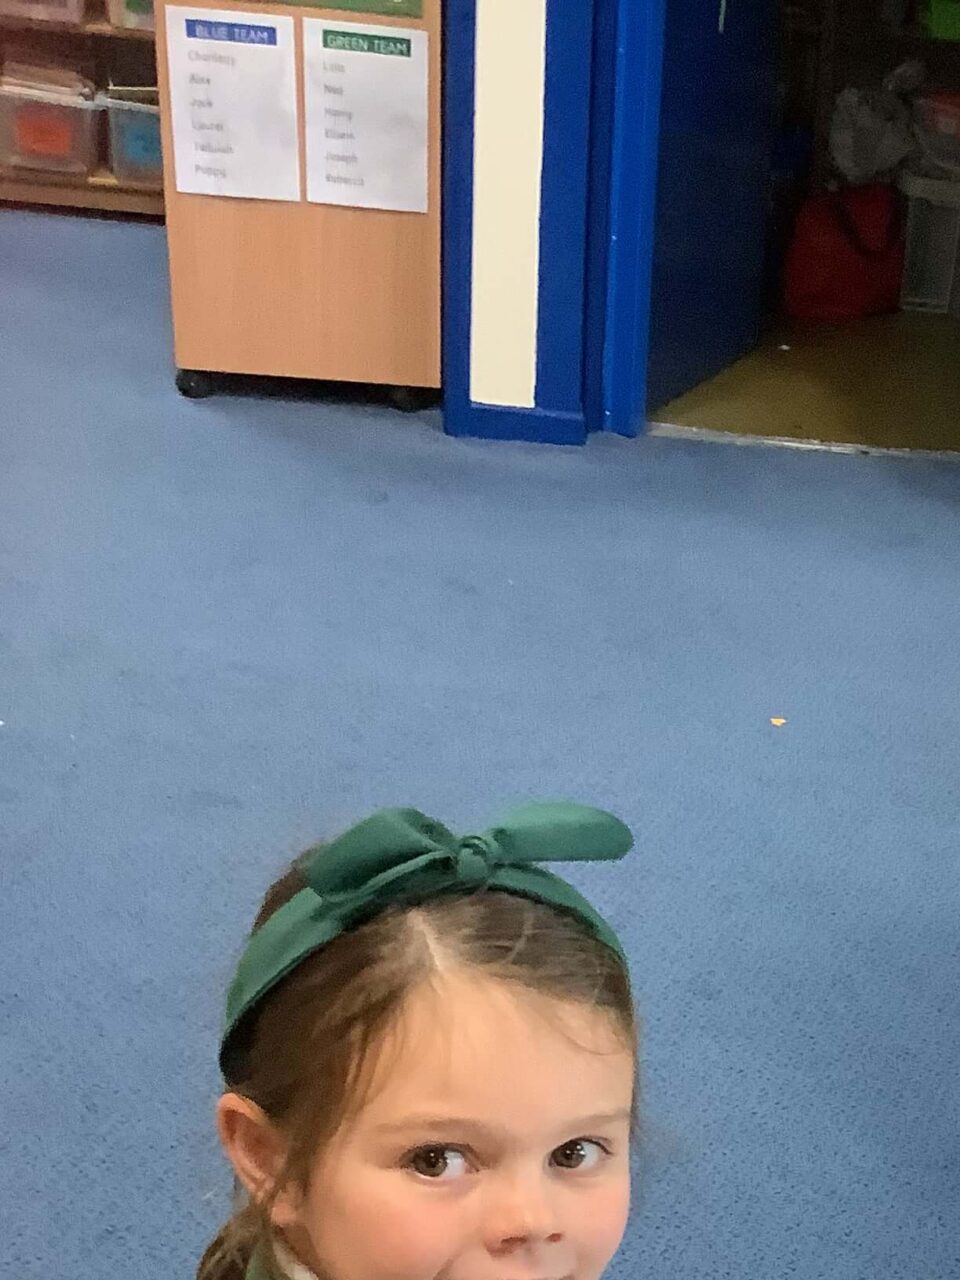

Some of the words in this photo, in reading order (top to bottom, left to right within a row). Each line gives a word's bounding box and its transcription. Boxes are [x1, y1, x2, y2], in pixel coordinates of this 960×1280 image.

[196, 25, 228, 39] BLUE
[234, 28, 268, 44] TEAM
[327, 35, 368, 50] GREEN
[374, 40, 408, 54] TEAM
